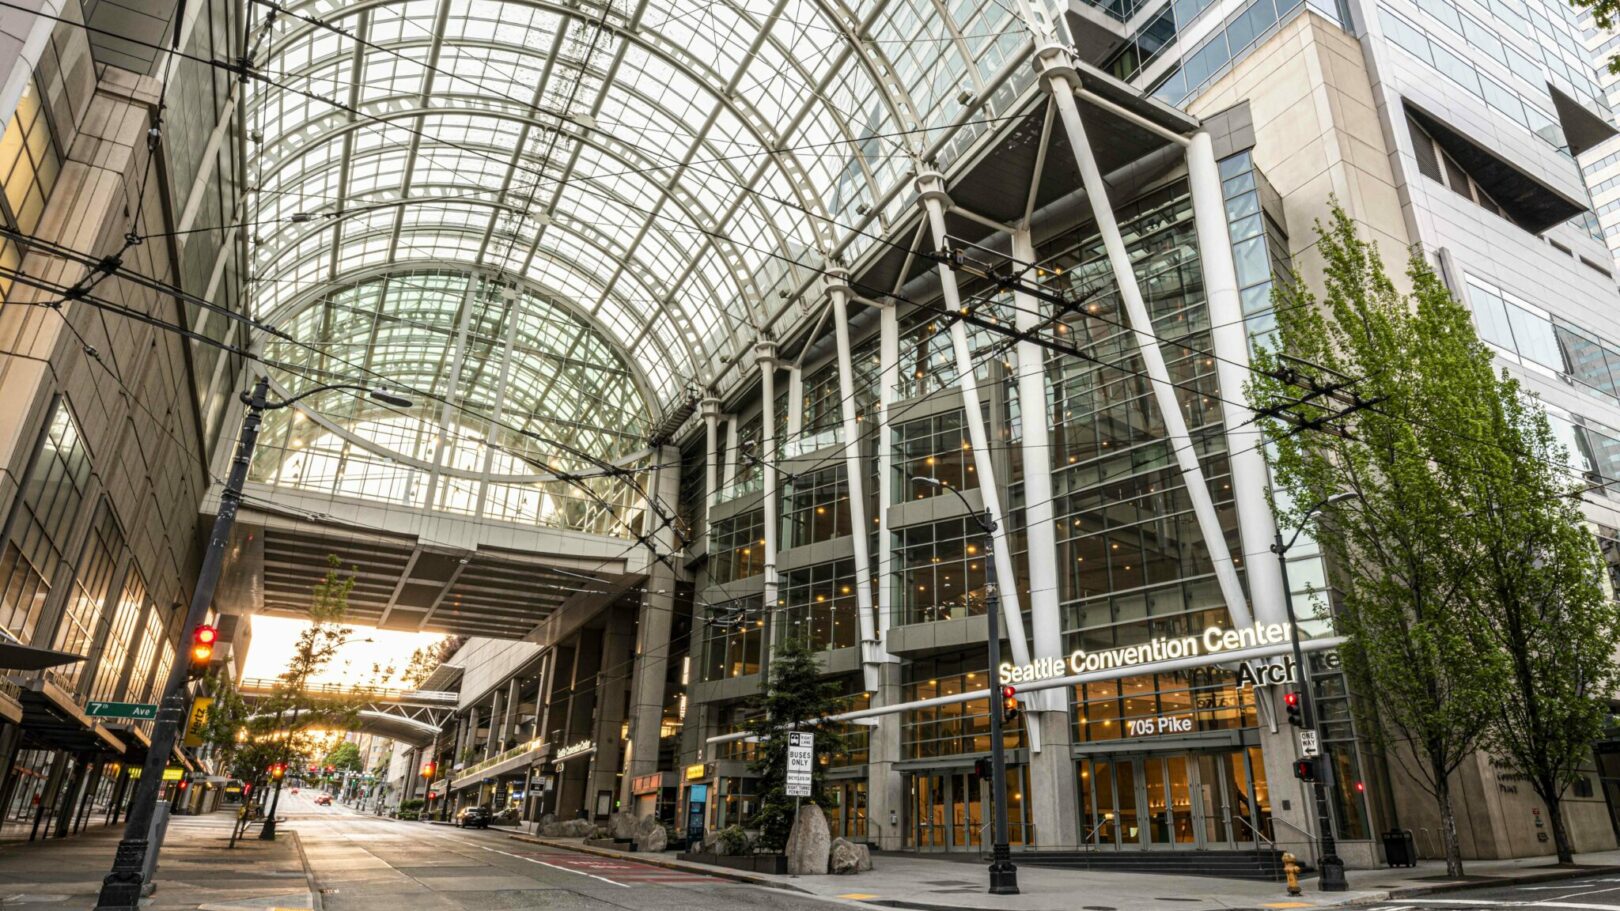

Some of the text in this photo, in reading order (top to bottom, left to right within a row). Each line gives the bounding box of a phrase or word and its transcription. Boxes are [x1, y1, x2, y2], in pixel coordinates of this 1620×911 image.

[999, 620, 1292, 684] Seattle Convention Center
[1236, 654, 1297, 689] Arch
[132, 707, 151, 716] Ave
[190, 708, 205, 734] Hertz
[1128, 716, 1192, 736] 705 Pike
[1301, 732, 1315, 740] ONE
[1302, 739, 1316, 747] WAY
[790, 751, 811, 759] BUSES
